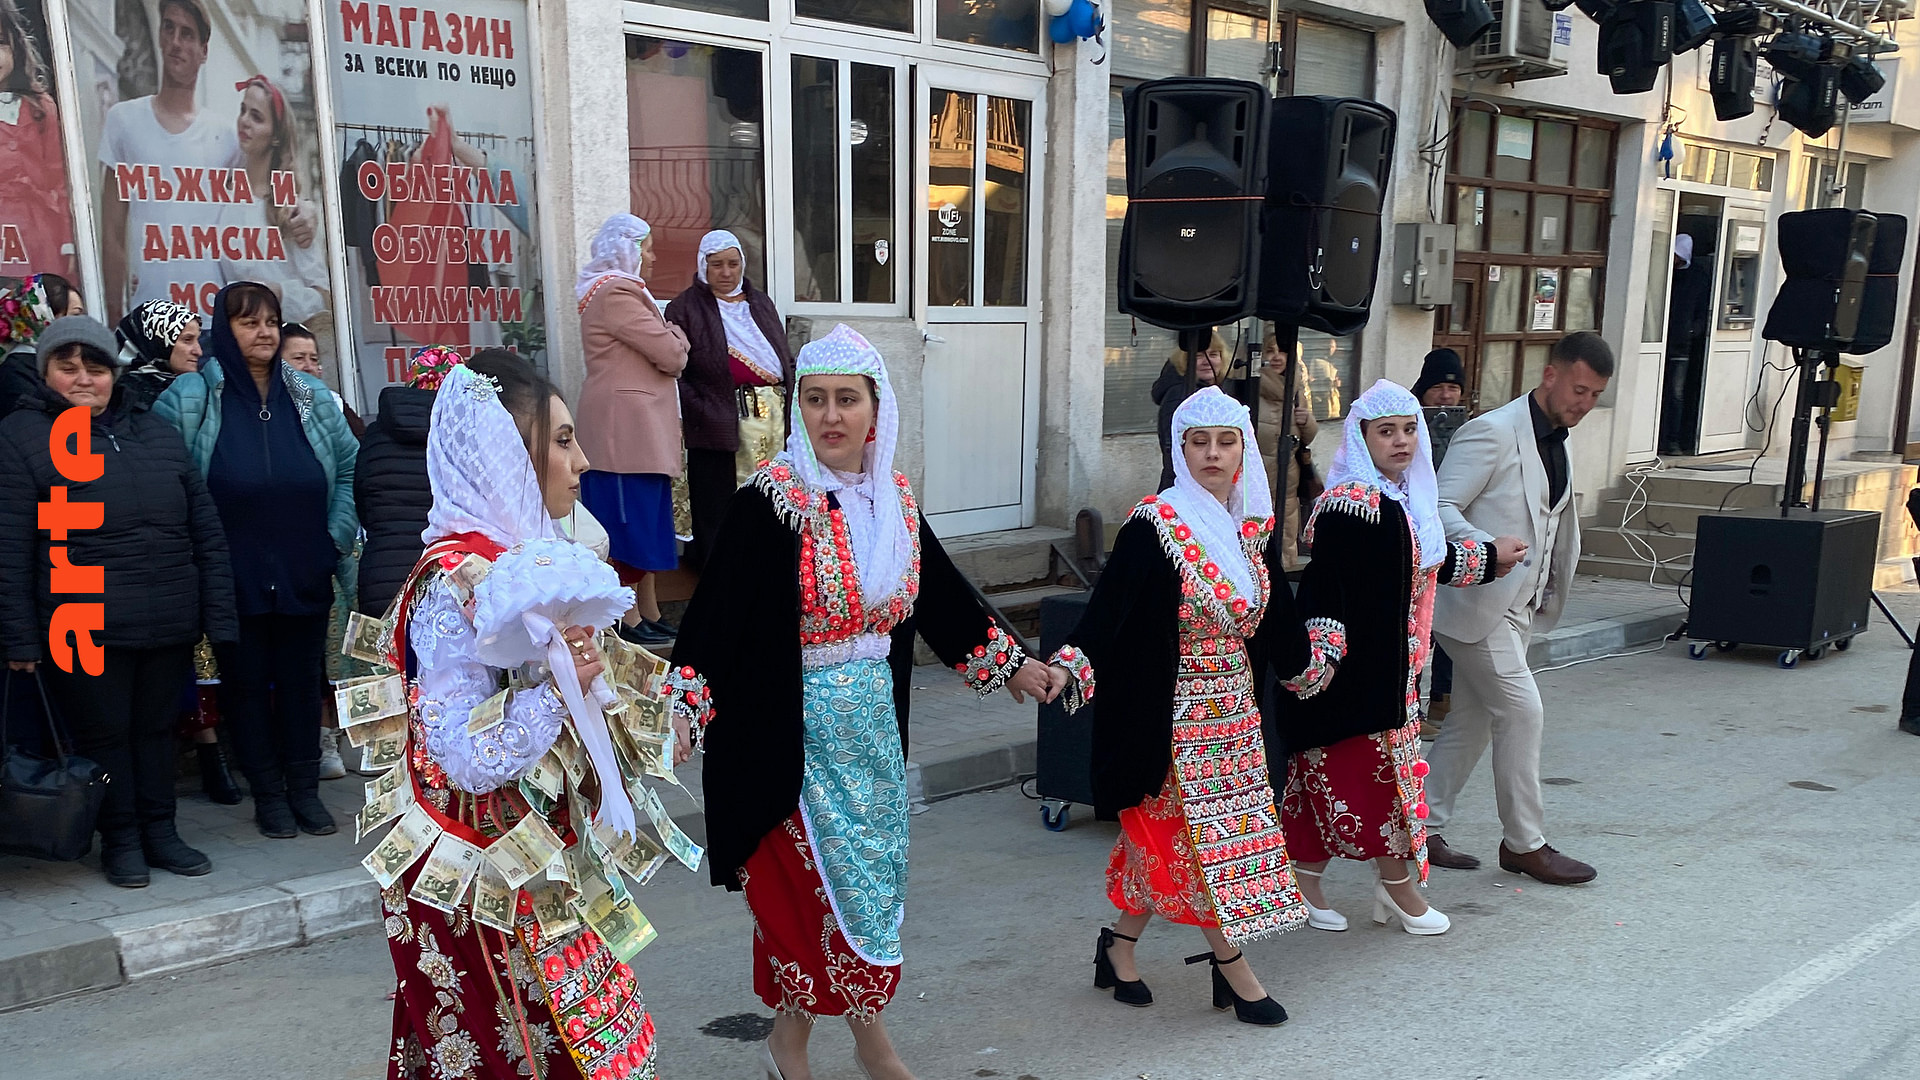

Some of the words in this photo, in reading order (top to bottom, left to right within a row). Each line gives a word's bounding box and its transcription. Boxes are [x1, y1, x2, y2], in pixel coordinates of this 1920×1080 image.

[340, 0, 515, 60] МАГАЗИН
[344, 52, 365, 73] ЗА
[375, 55, 428, 79] ВСЕКИ
[437, 61, 461, 82] ПО
[470, 65, 517, 90] НЕЩО
[115, 163, 253, 204] МЪЖКА
[271, 169, 298, 207] И
[357, 160, 520, 206] ОБЛЕКЛА
[143, 223, 287, 262] ДАМСКА
[372, 223, 514, 265] ОБУВКИ
[942, 228, 957, 236] ZONE
[1180, 228, 1197, 238] RCF
[371, 286, 524, 324] КИЛИМИ
[421, 824, 432, 836] 10
[462, 850, 474, 862] 10
